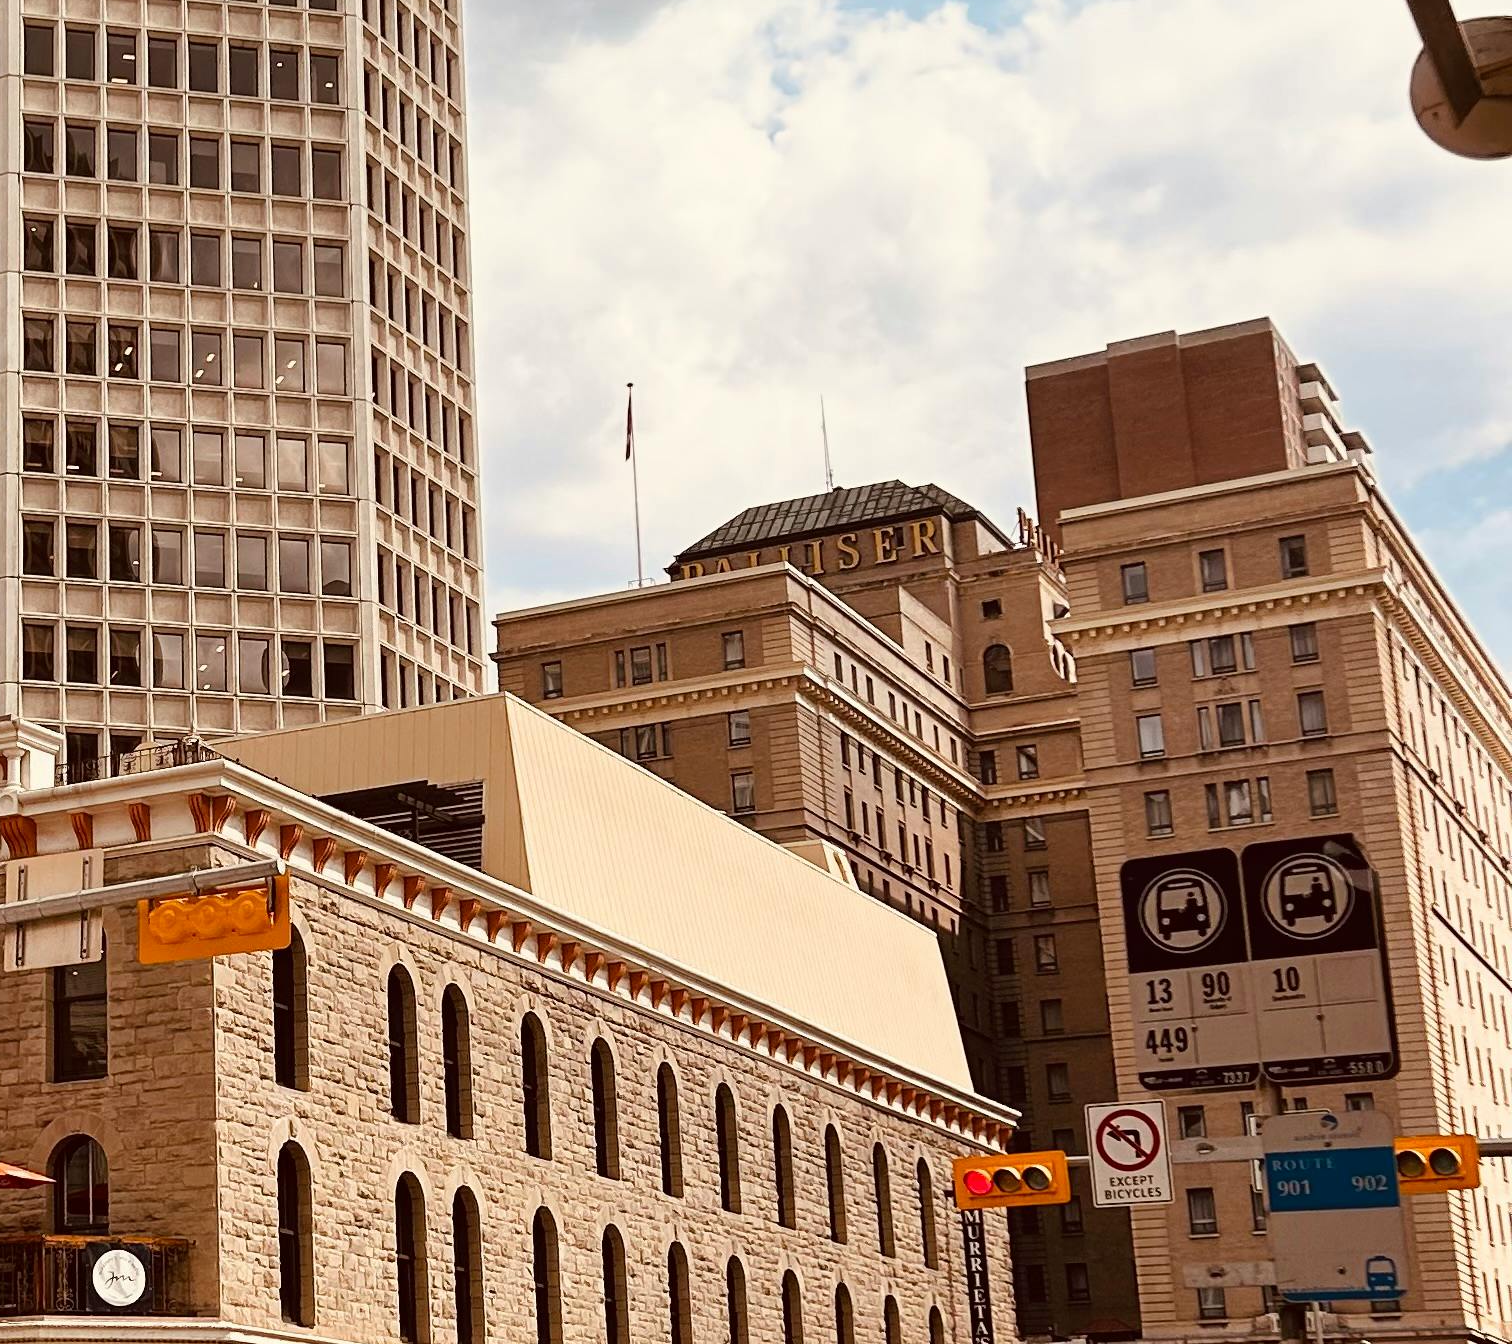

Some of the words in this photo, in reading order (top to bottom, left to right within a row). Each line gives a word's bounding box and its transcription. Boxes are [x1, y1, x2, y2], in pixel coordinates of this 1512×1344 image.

[1146, 978, 1173, 1005] 13
[1201, 971, 1231, 998] 90
[1272, 966, 1300, 993] 10
[1146, 1026, 1188, 1055] 449
[1271, 1156, 1336, 1172] ROUTE
[1109, 1174, 1154, 1187] EXCEPT
[1276, 1179, 1311, 1197] 901
[1351, 1174, 1389, 1192] 902
[1104, 1187, 1162, 1200] BICYCLES
